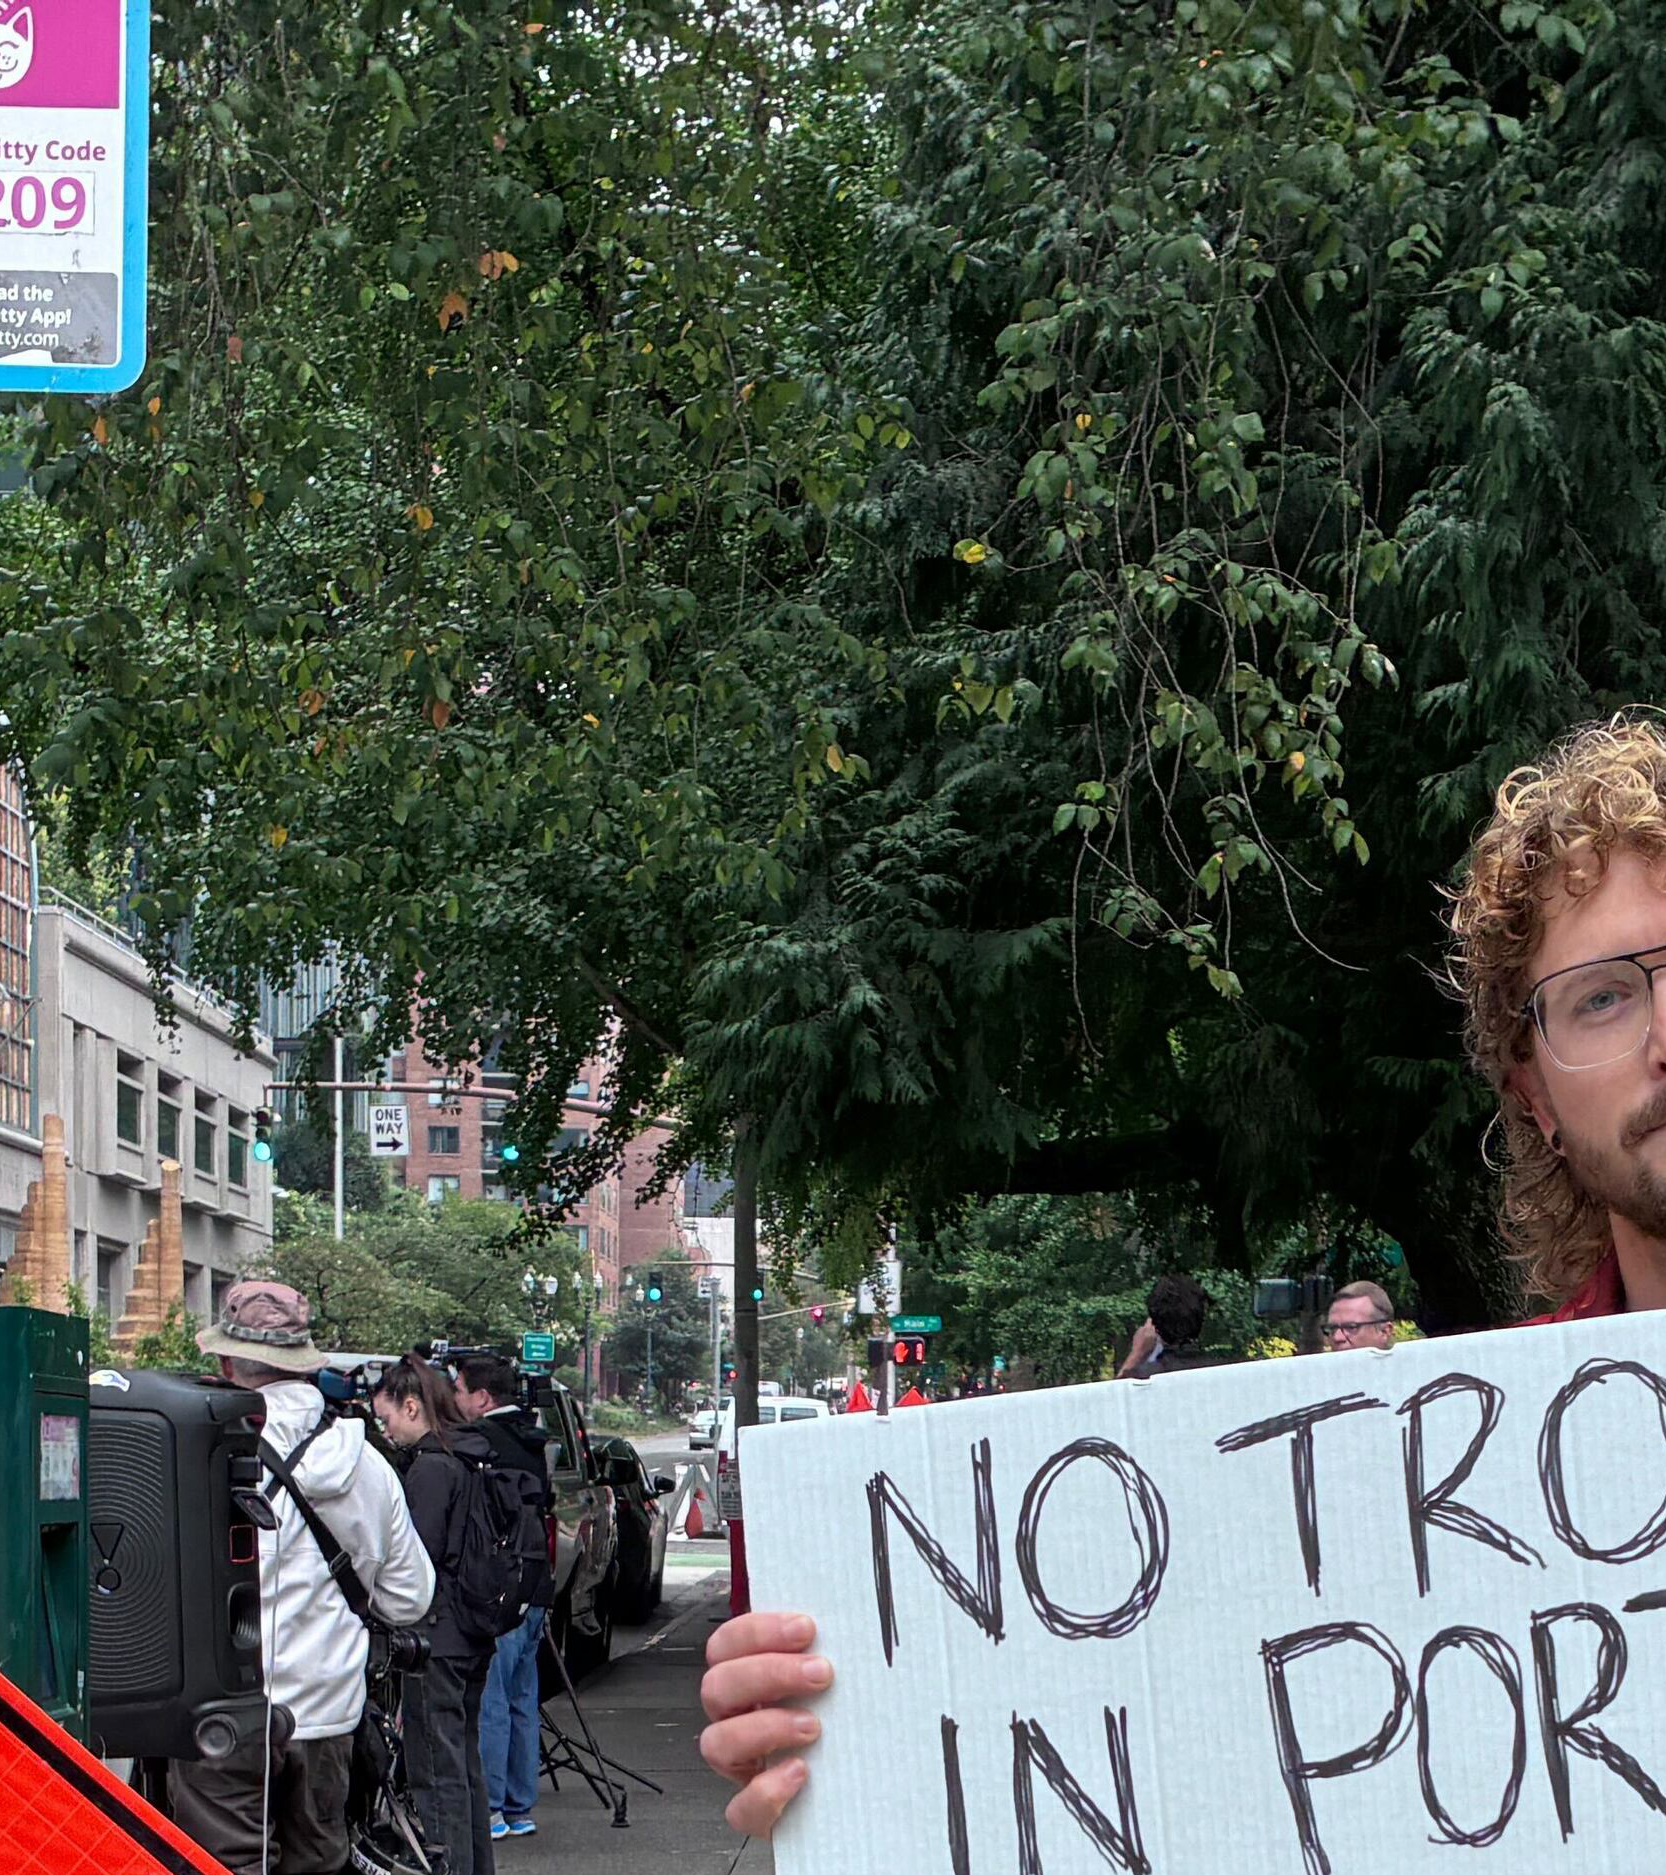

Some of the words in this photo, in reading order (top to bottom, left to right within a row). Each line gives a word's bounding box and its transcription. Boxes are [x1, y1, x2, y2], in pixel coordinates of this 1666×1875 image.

[45, 140, 107, 162] Code
[23, 284, 54, 302] the
[30, 307, 72, 328] App!
[375, 1108, 403, 1121] ONE
[375, 1122, 403, 1135] WAY
[865, 1434, 1169, 1669] NO
